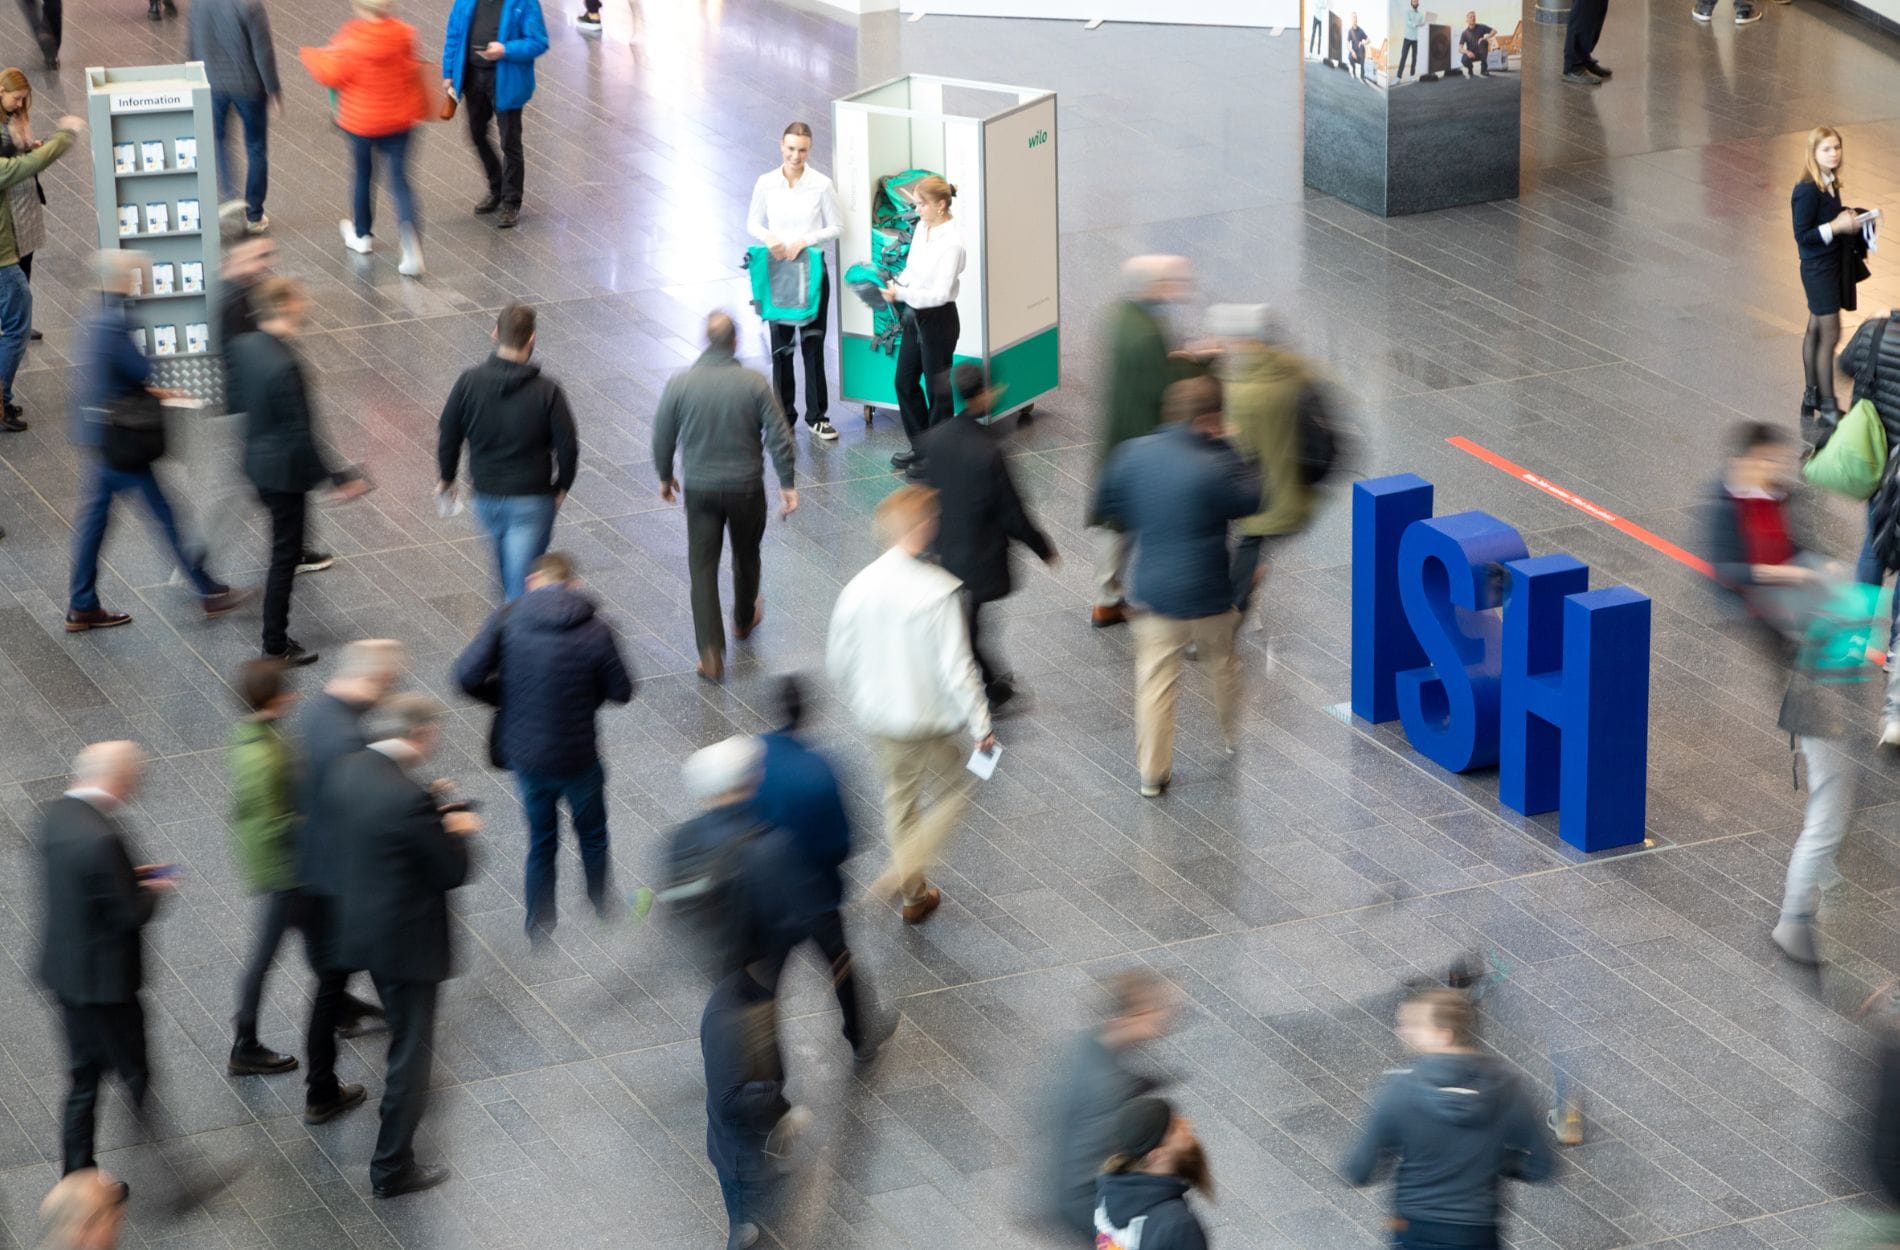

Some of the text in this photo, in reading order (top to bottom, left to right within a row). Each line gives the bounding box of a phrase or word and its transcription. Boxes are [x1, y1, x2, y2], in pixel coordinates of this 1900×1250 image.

[118, 95, 181, 107] Information
[1028, 129, 1047, 148] wilo
[1352, 473, 1651, 853] ISH
